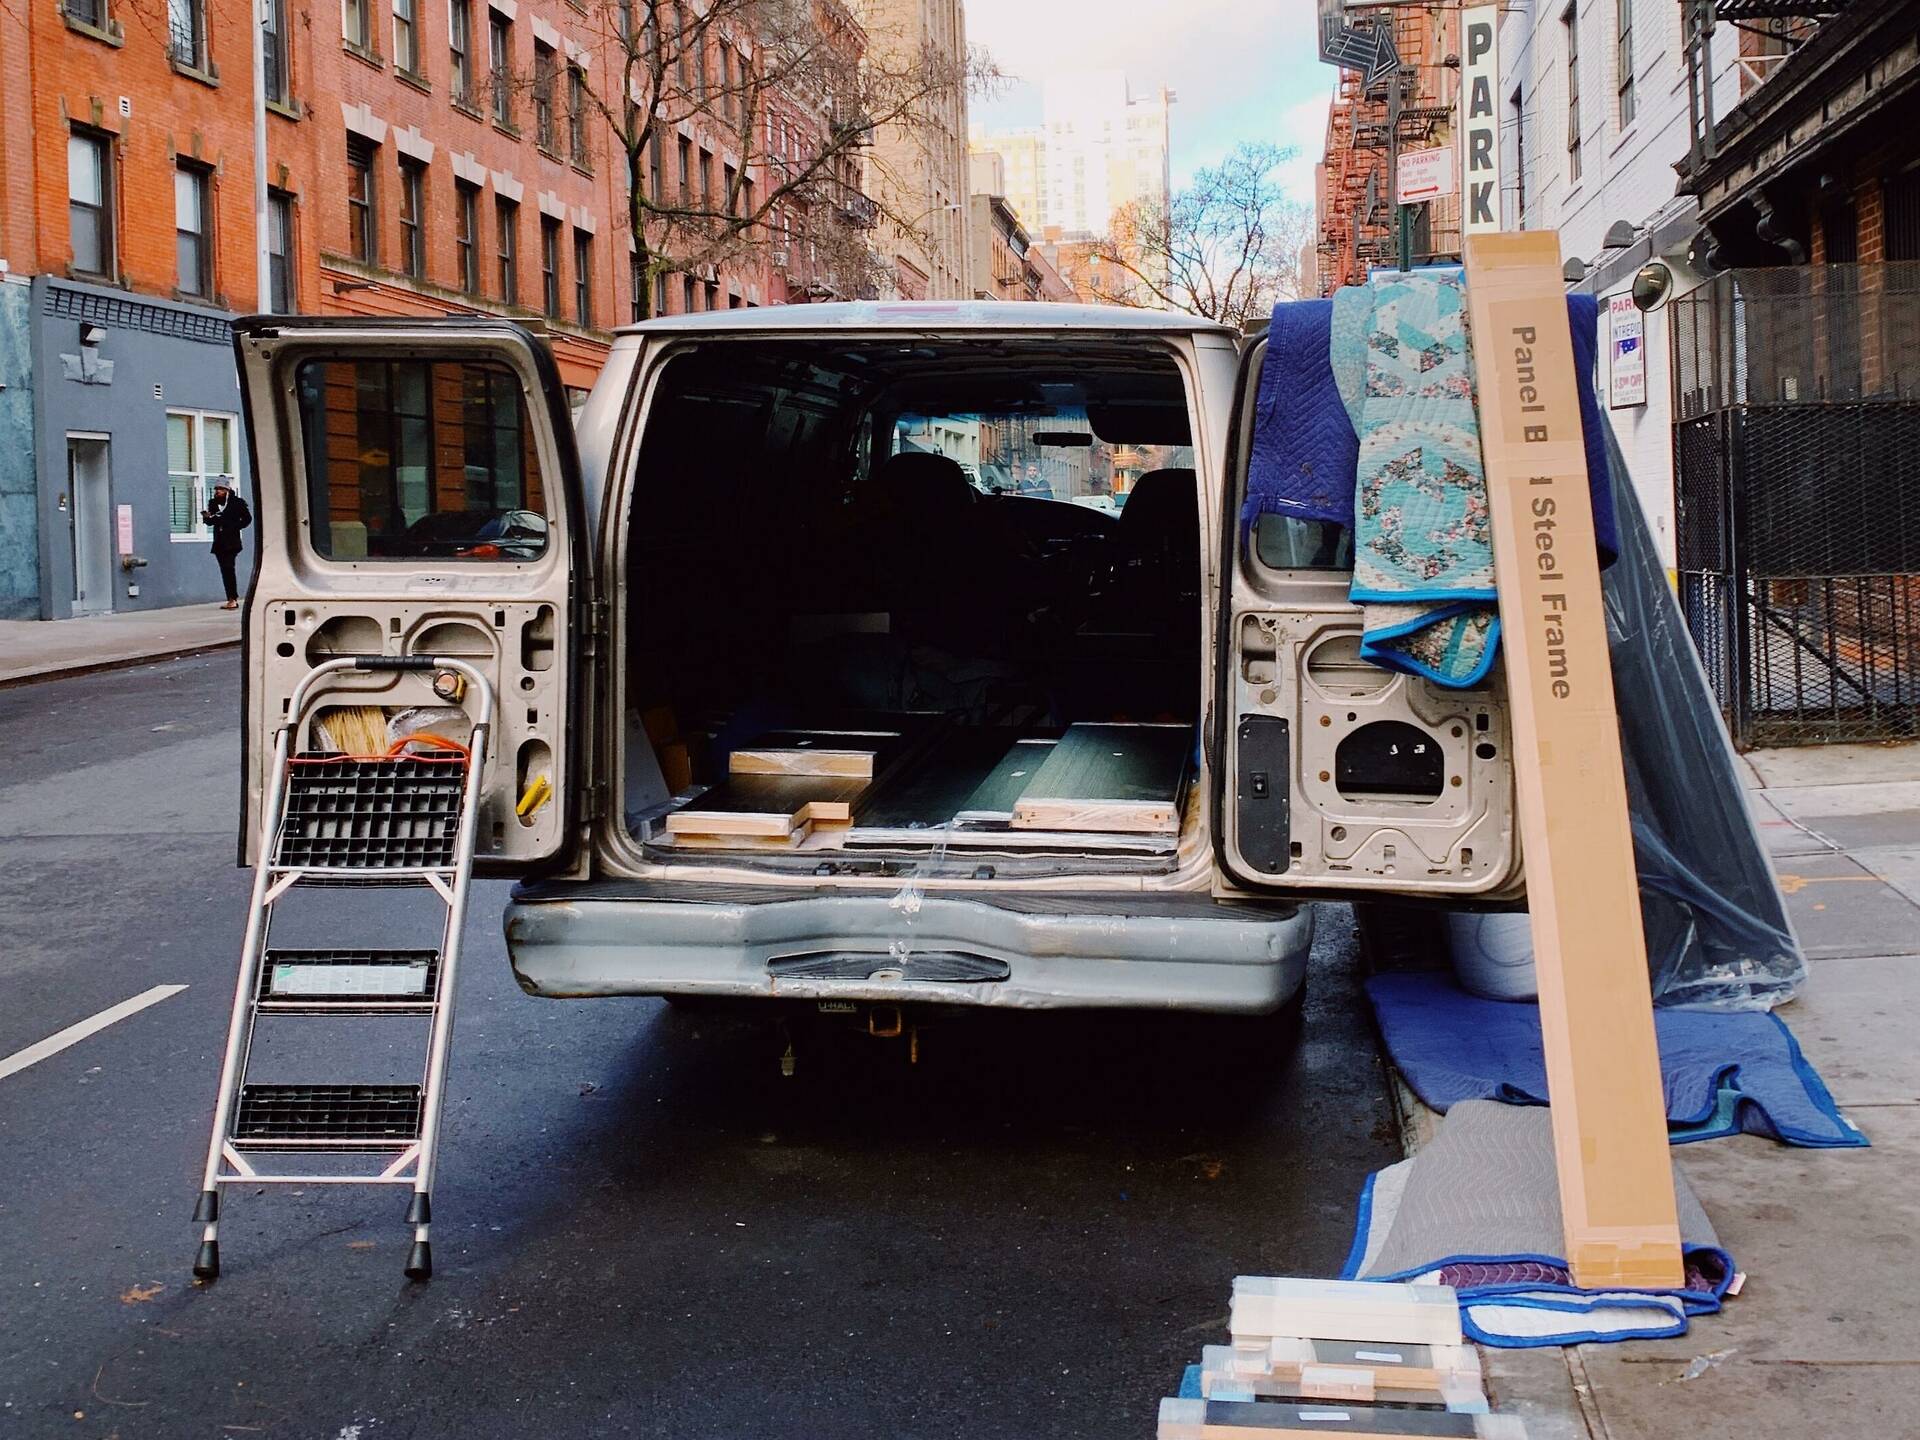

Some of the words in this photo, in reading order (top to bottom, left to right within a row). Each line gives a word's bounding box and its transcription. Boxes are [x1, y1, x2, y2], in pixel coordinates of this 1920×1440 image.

[1401, 158, 1411, 168] NO
[1412, 152, 1440, 166] PARKING
[1468, 22, 1495, 224] PARK
[1612, 298, 1635, 314] PAR
[1512, 326, 1545, 412] Panel
[1531, 497, 1564, 580] Steel
[1541, 594, 1570, 699] Frame
